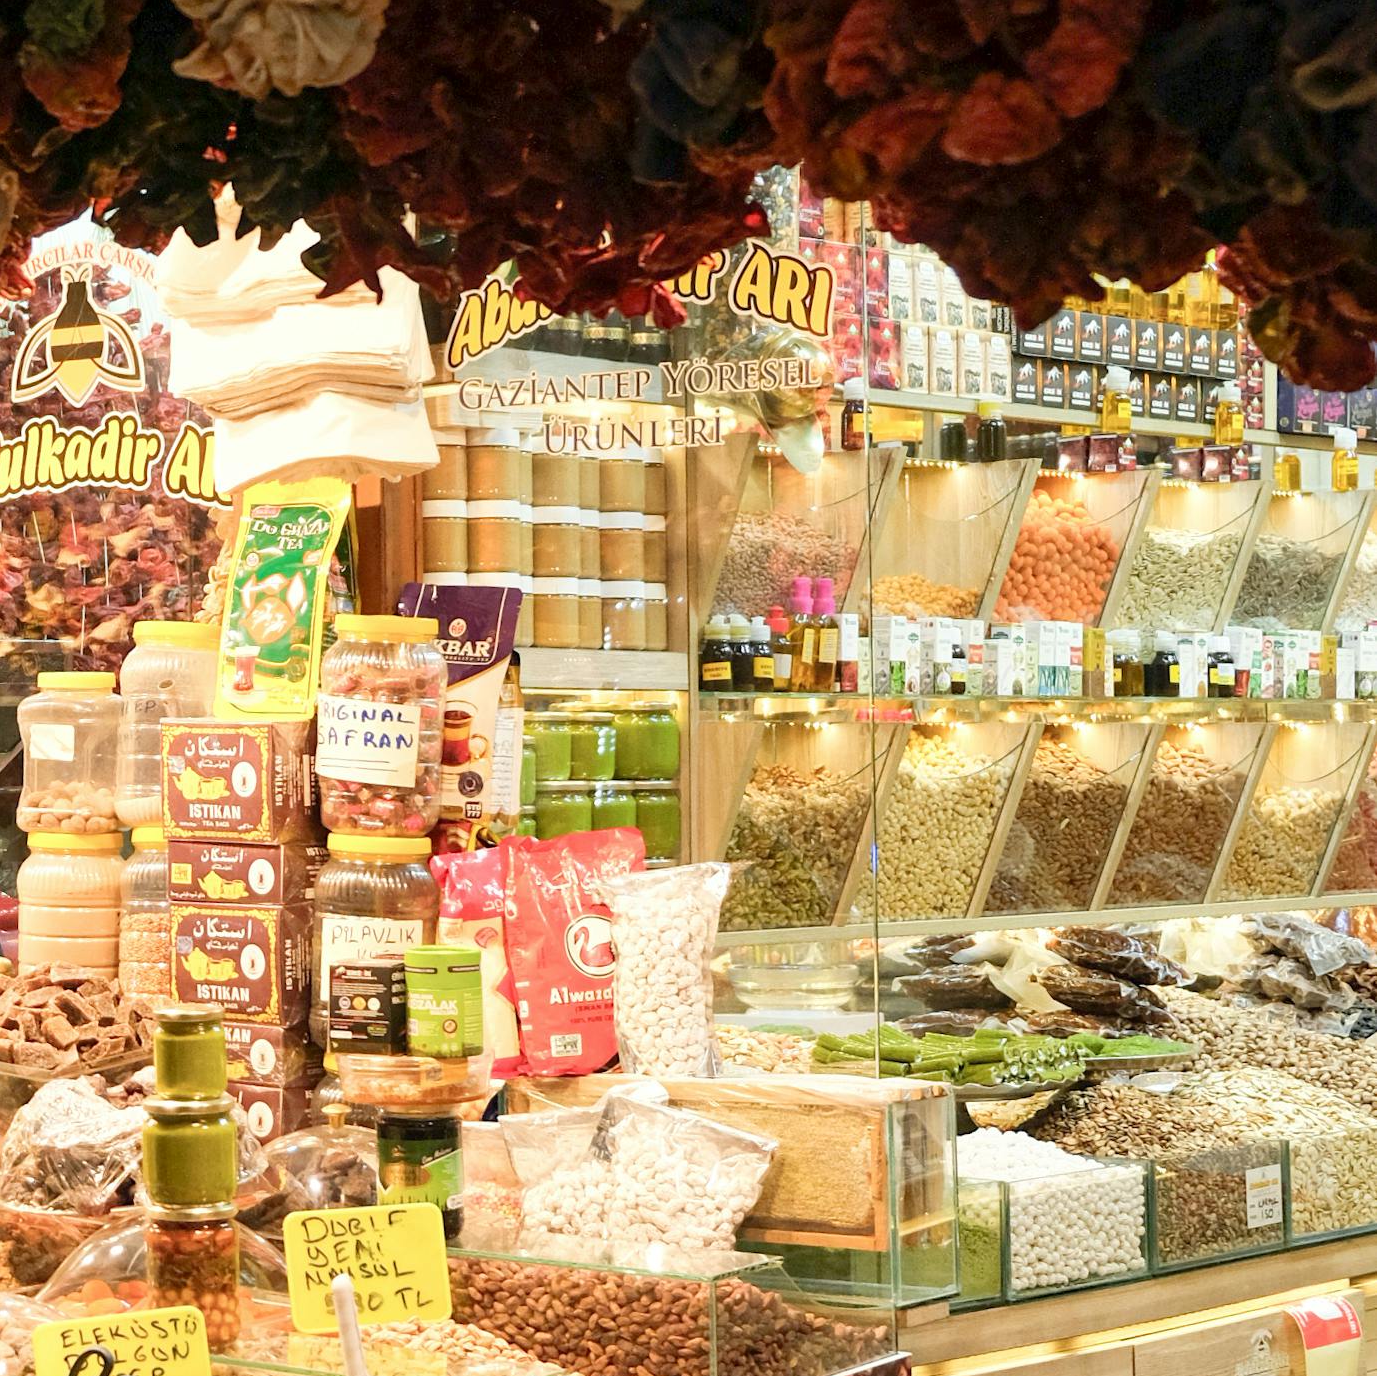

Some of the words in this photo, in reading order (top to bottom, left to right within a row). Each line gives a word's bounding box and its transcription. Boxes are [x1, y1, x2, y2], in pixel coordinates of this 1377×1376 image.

[733, 245, 832, 337] ARI
[458, 369, 651, 411] GAZİANTEP
[660, 356, 823, 398] YÖRESEL
[543, 409, 724, 454] ÜRÜNLERİ
[432, 638, 491, 658] KBAR
[188, 803, 241, 820] ISTIKAN
[196, 983, 250, 1002] ISTIKAN
[549, 986, 613, 1005] Alwaza
[395, 1286, 434, 1310] TL
